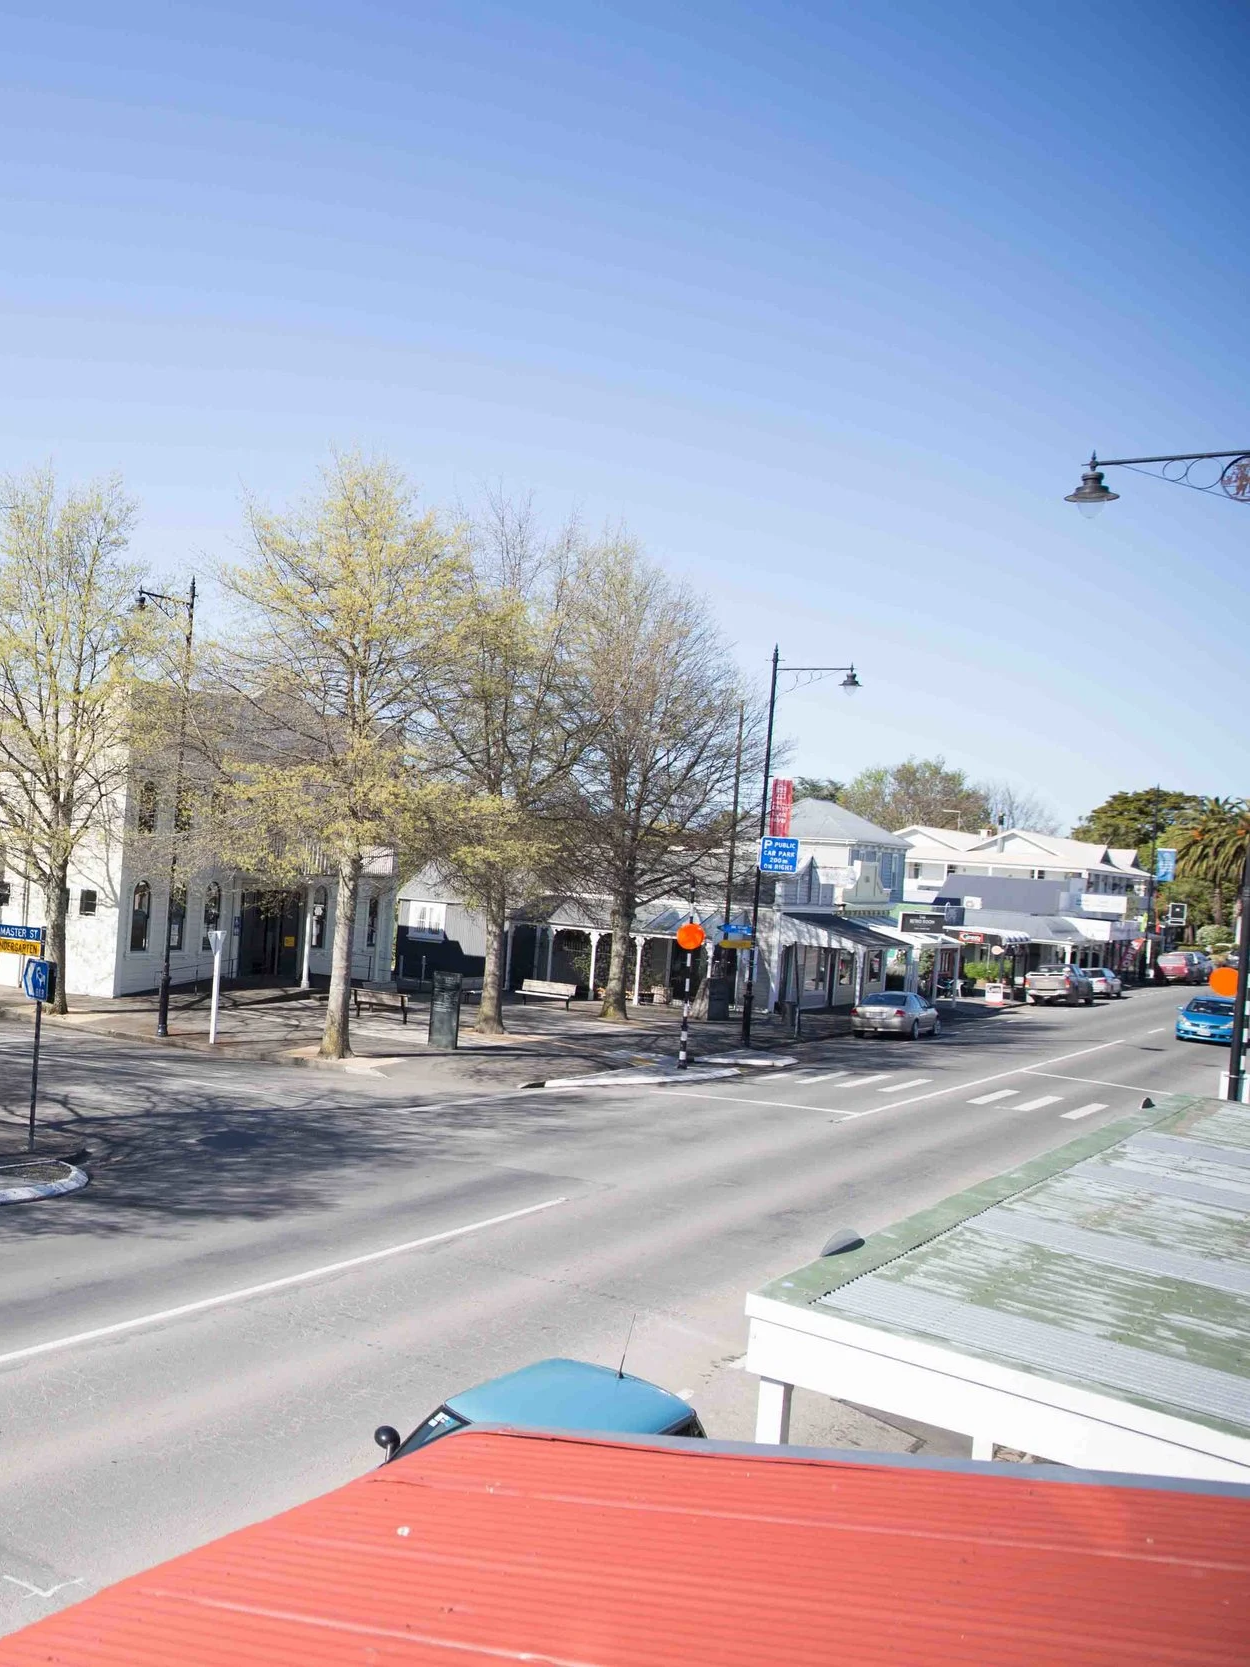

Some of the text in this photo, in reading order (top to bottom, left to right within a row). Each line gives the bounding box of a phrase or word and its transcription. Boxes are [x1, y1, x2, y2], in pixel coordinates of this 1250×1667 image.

[764, 840, 773, 849] P
[774, 863, 793, 871] RIGHT
[29, 929, 39, 939] ST
